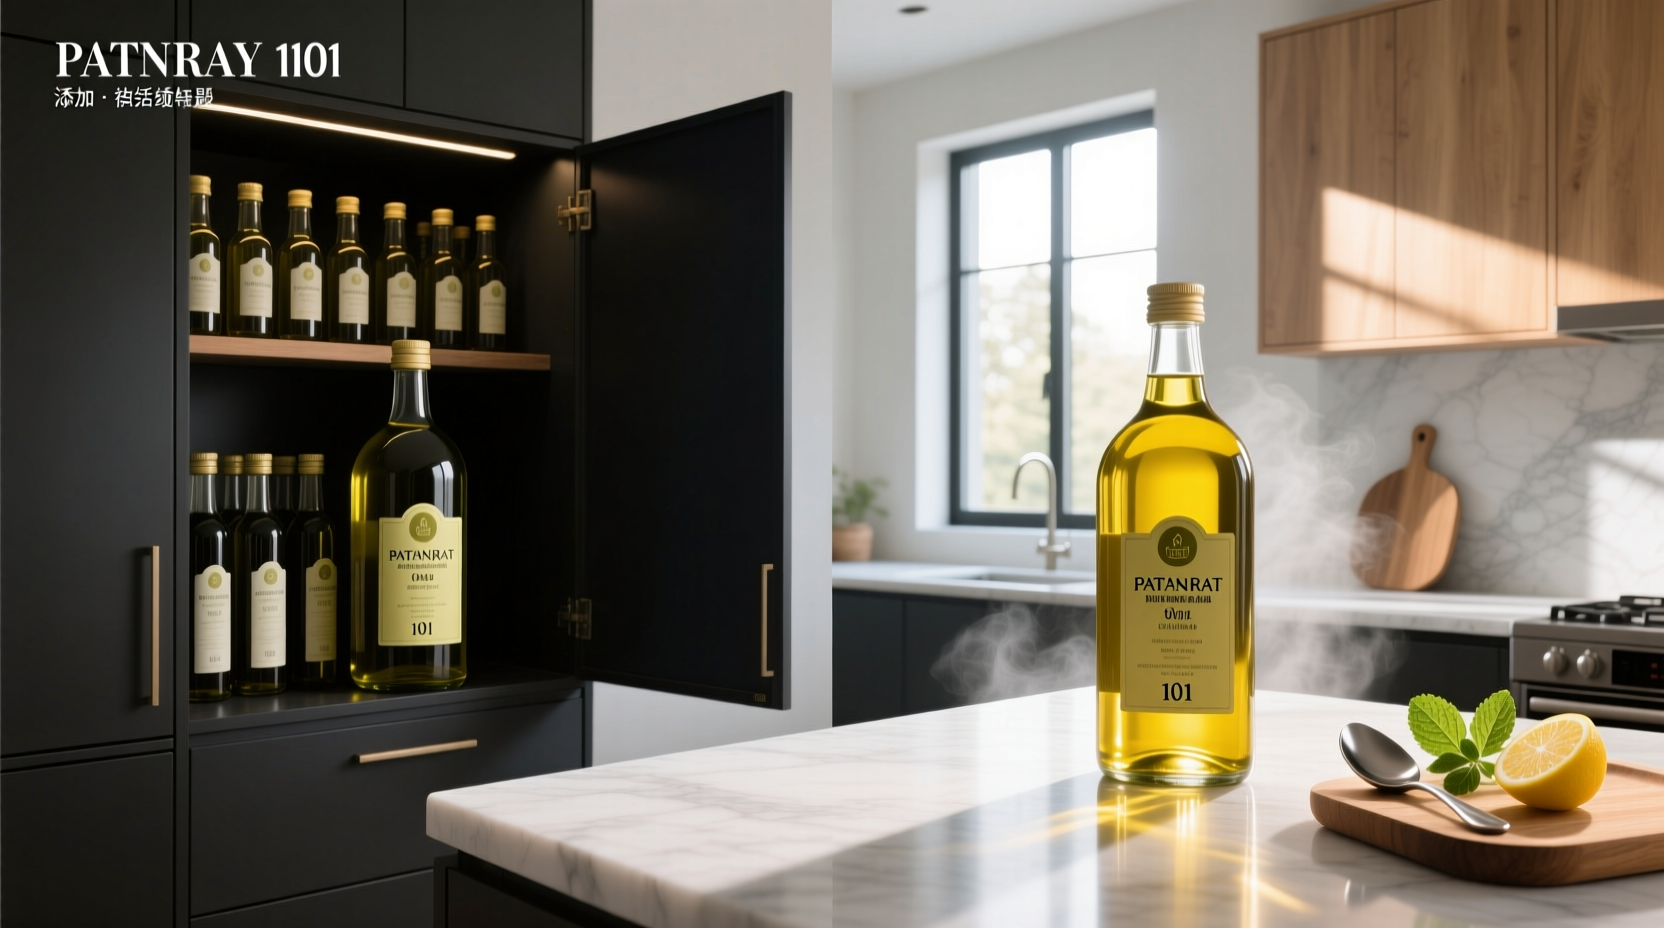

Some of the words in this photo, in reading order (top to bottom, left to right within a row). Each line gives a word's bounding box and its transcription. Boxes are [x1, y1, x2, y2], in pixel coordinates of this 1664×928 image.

[389, 549, 455, 562] PATANRAT
[1134, 576, 1223, 592] PATANRAT
[411, 621, 433, 636] 101
[1161, 682, 1193, 702] 101
